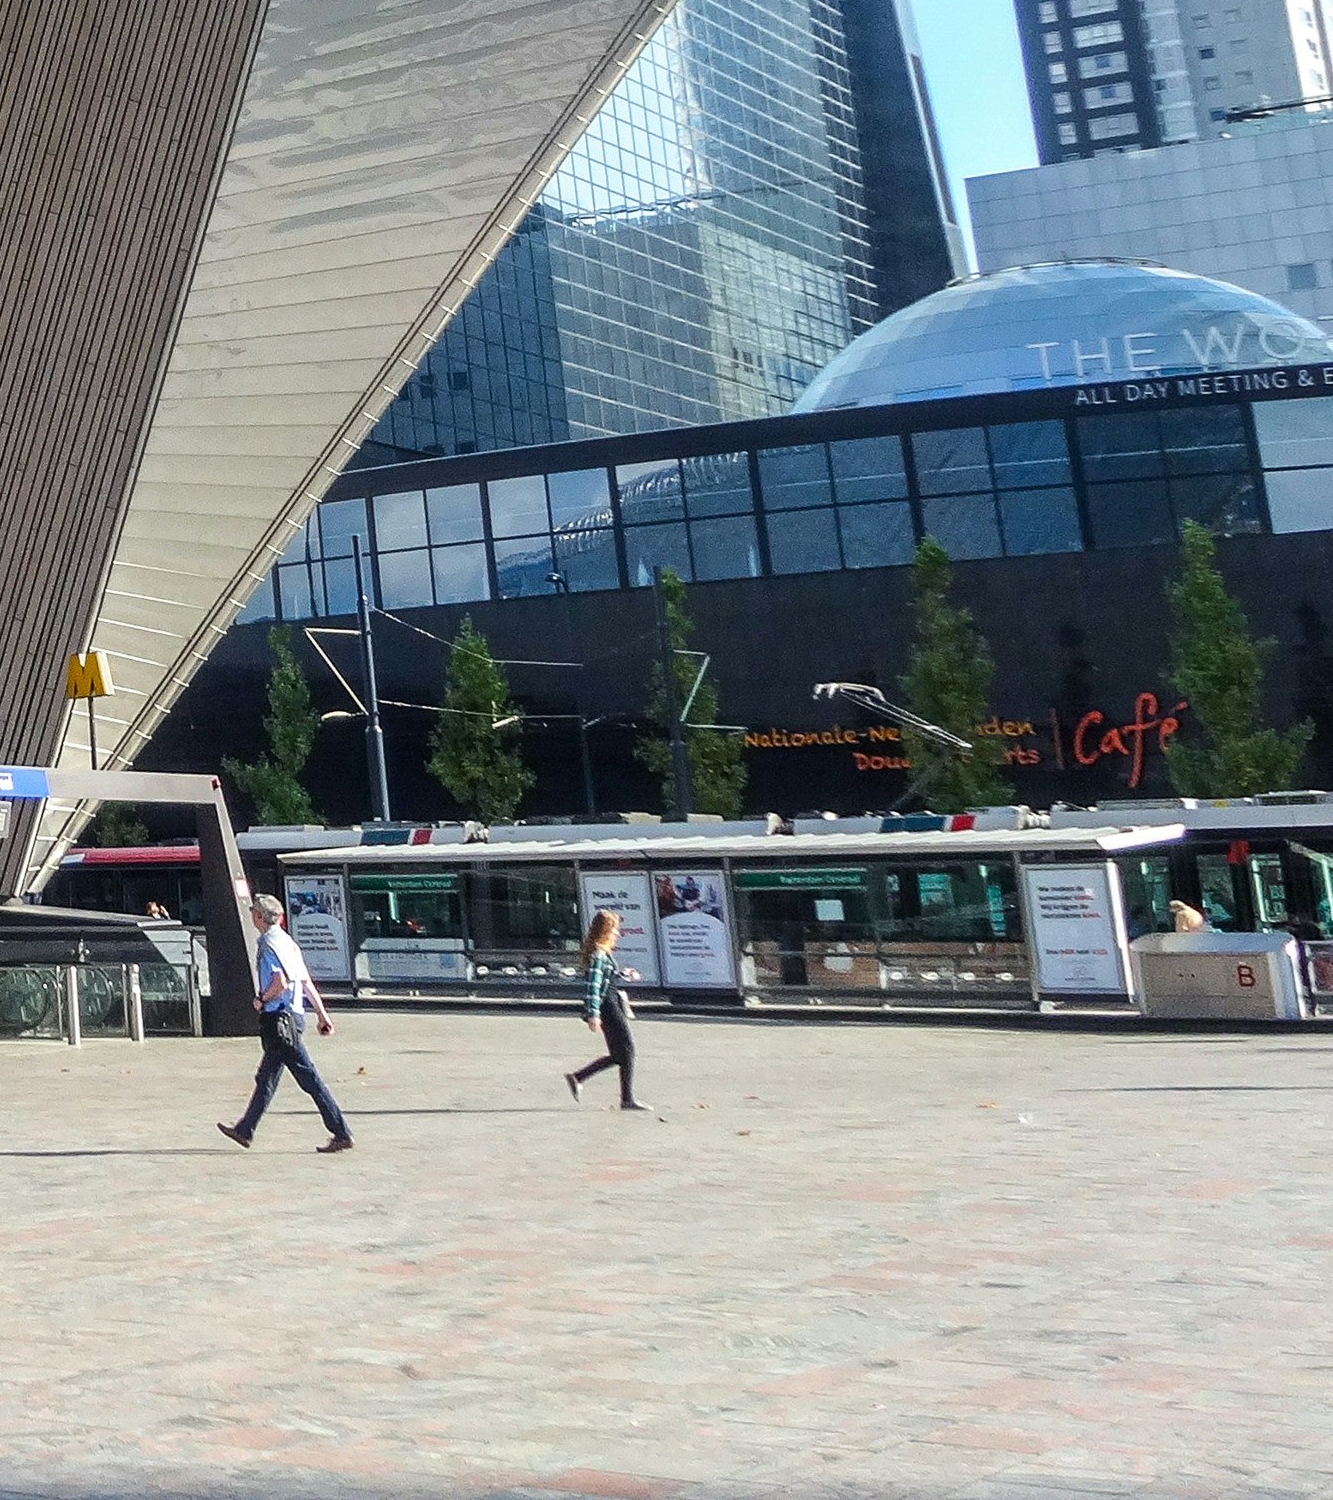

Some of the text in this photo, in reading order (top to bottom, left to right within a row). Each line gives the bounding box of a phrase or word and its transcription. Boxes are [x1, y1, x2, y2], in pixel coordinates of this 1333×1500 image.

[1026, 332, 1161, 380] THE
[1075, 387, 1117, 406] ALL
[1125, 380, 1172, 401] DAY
[1178, 371, 1290, 396] MEETING
[1298, 369, 1315, 388] &
[67, 652, 113, 699] M
[1073, 692, 1187, 789] Café
[1237, 964, 1256, 987] B
